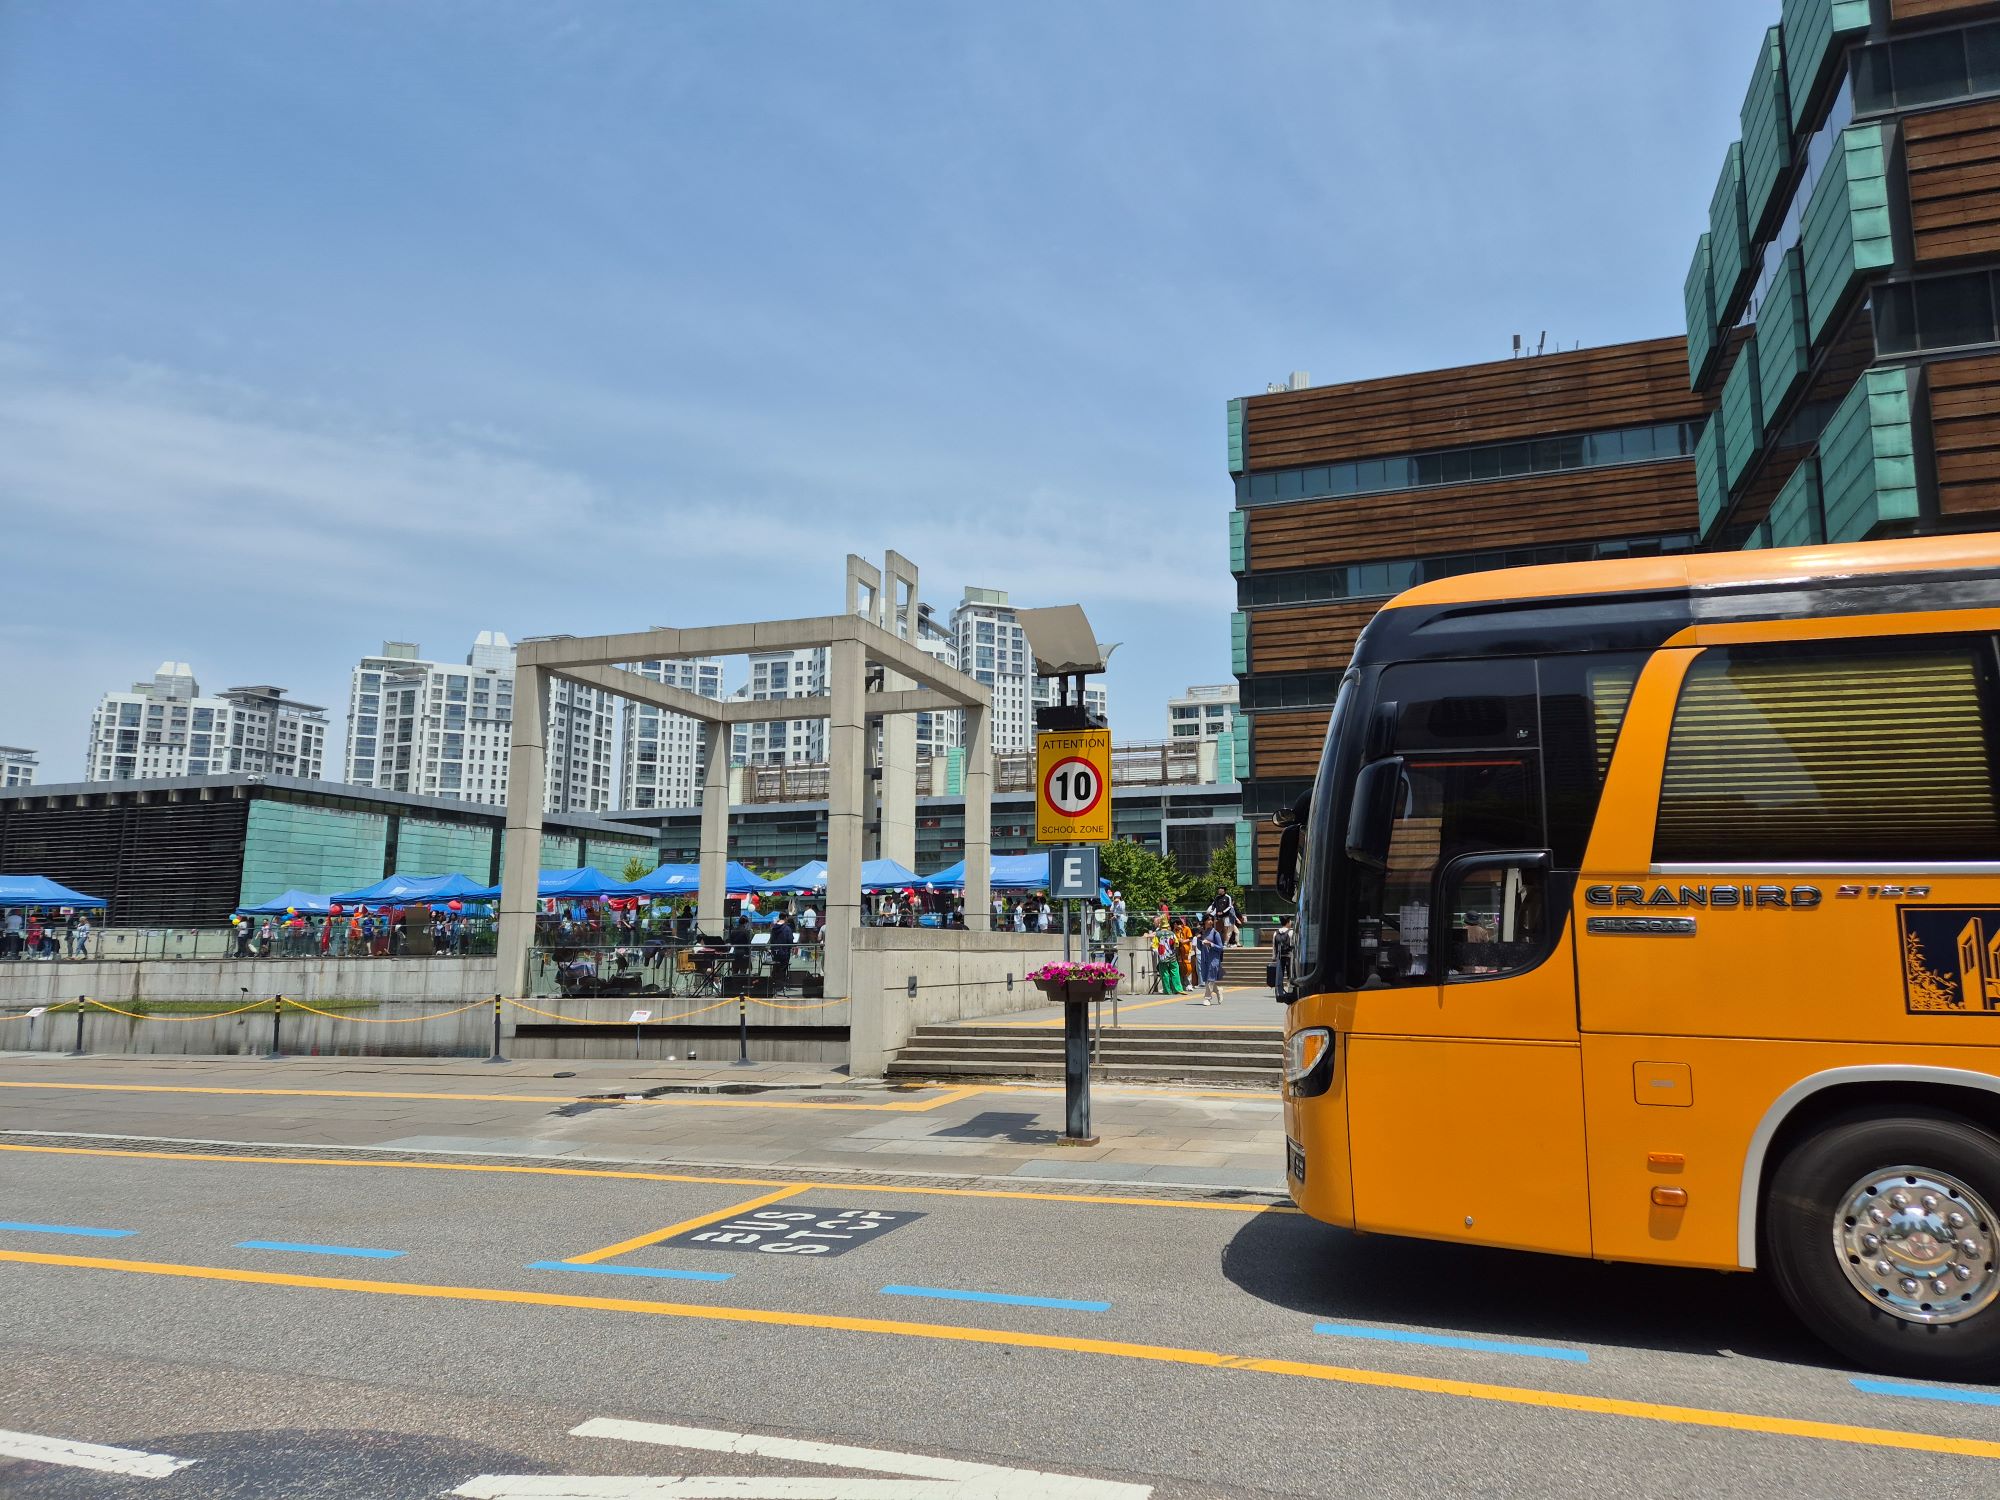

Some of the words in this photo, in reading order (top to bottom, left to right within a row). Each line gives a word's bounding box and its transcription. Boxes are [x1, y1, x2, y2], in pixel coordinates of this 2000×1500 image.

[1043, 738, 1105, 750] ATTENTION
[1056, 771, 1091, 801] 10
[1041, 825, 1078, 834] SCHOOL
[1080, 825, 1104, 834] ZONE
[1063, 857, 1083, 888] E
[1585, 884, 1823, 907] GRANBIRD
[1592, 919, 1693, 932] SILKROAD
[690, 1211, 817, 1244] BUS
[758, 1210, 897, 1254] STOP
